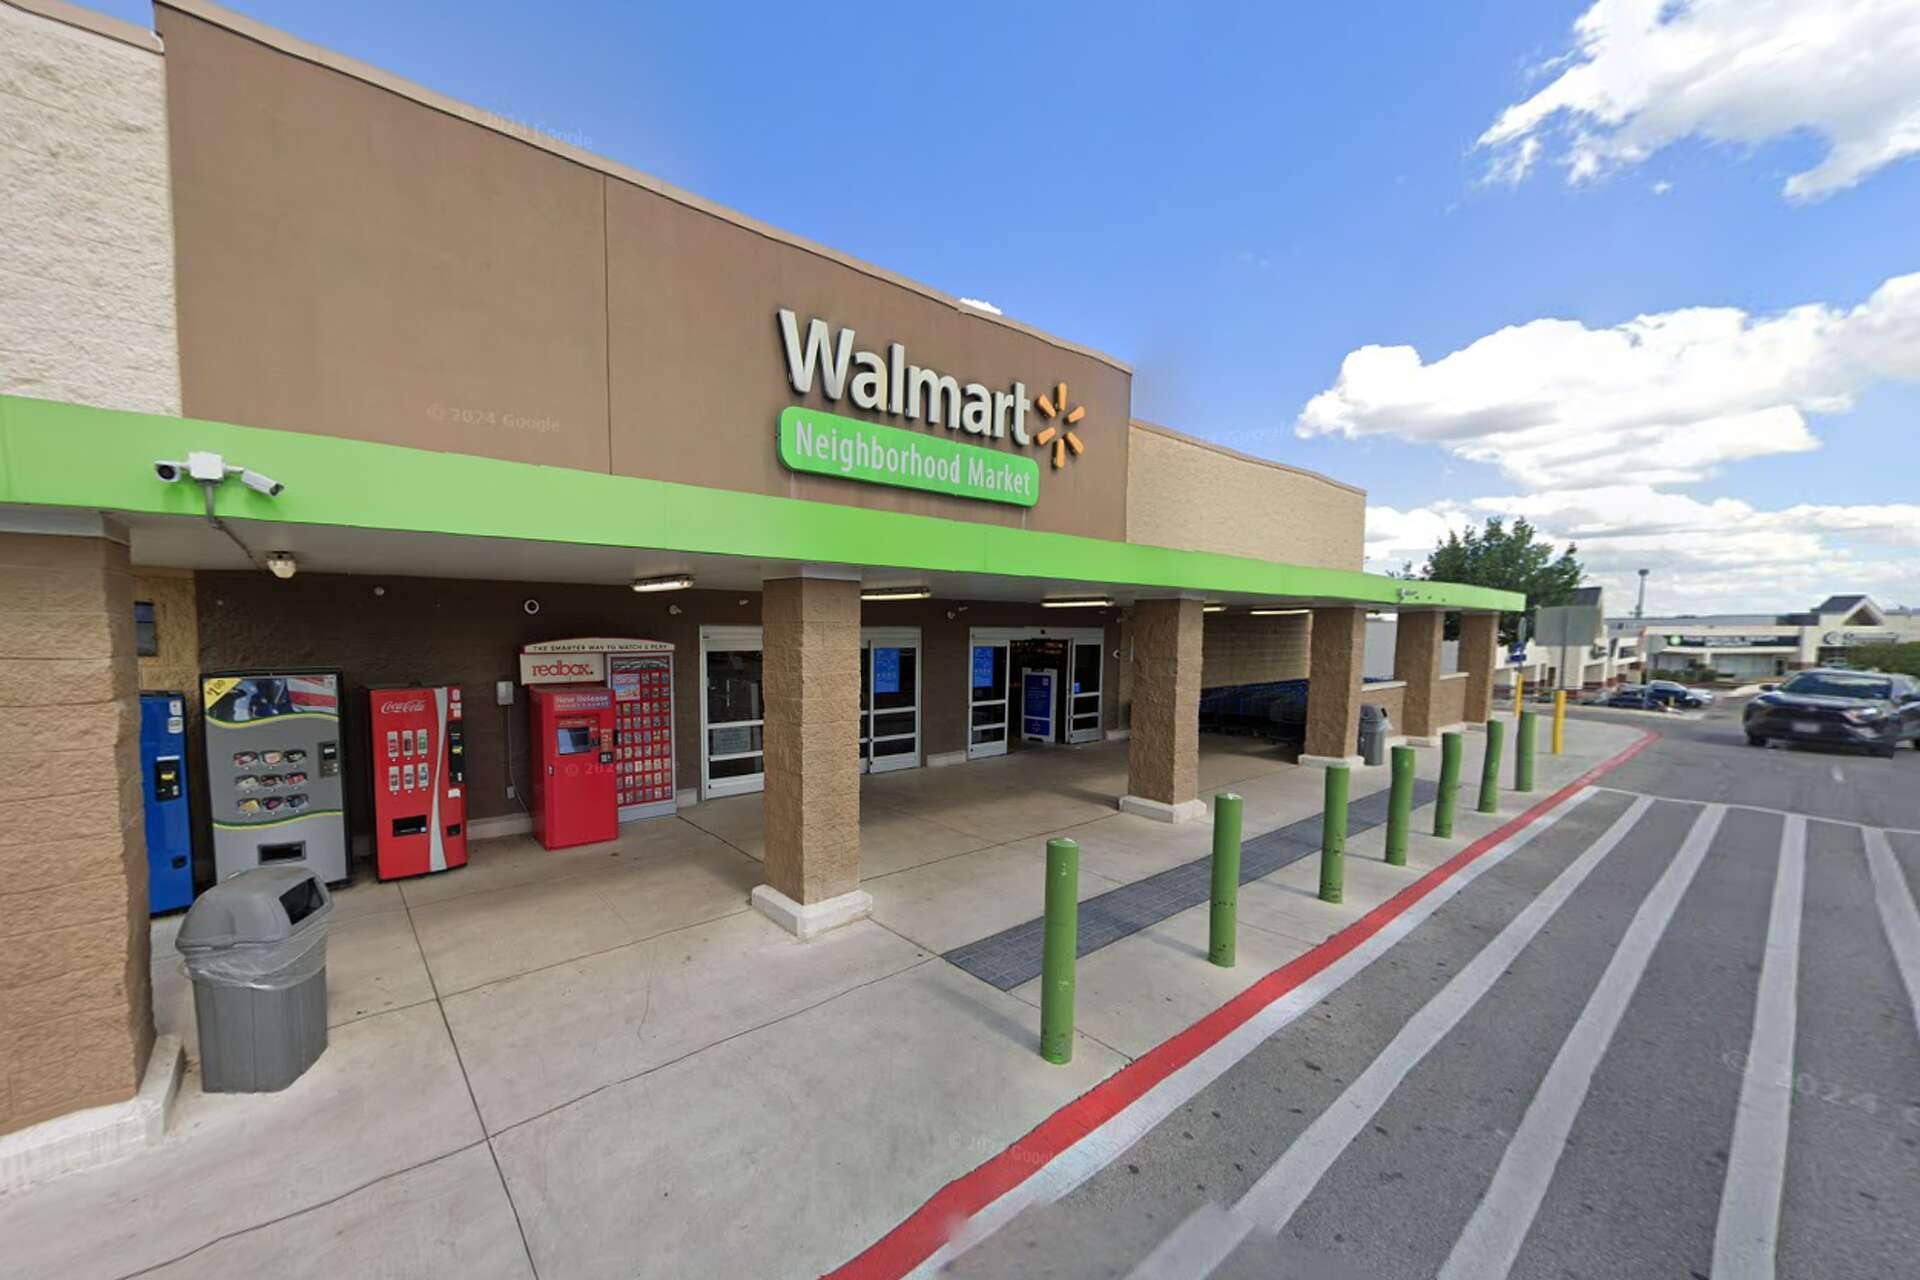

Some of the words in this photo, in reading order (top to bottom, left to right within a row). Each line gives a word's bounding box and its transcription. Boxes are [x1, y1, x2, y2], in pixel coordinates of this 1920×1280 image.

[777, 308, 1031, 446] Walmart
[795, 421, 961, 483] Neighborhood
[967, 456, 1032, 497] Market
